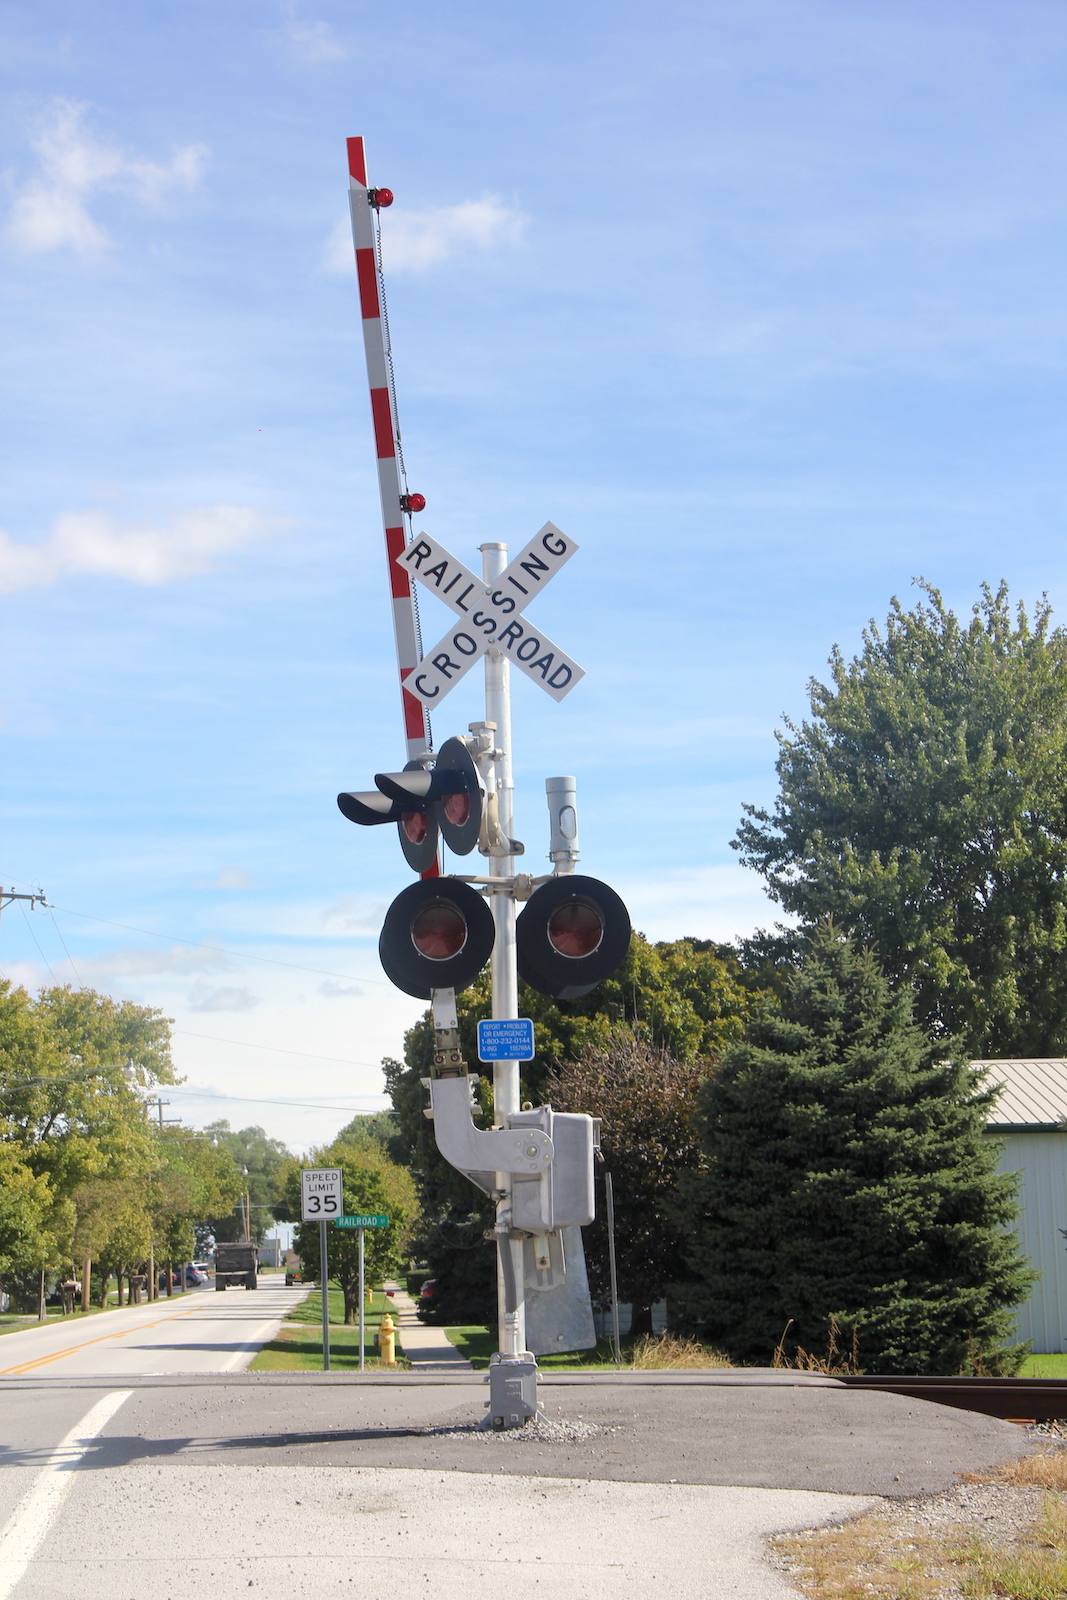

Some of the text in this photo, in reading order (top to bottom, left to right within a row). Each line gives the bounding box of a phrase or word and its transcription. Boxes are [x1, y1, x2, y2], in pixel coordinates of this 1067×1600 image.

[415, 532, 567, 698] CROSSING
[481, 1037, 530, 1045] 1-800-232-0144
[305, 1172, 338, 1182] SPEED
[308, 1183, 335, 1192] LIMIT
[307, 1195, 338, 1214] 35
[338, 1216, 378, 1226] RAILROAD
